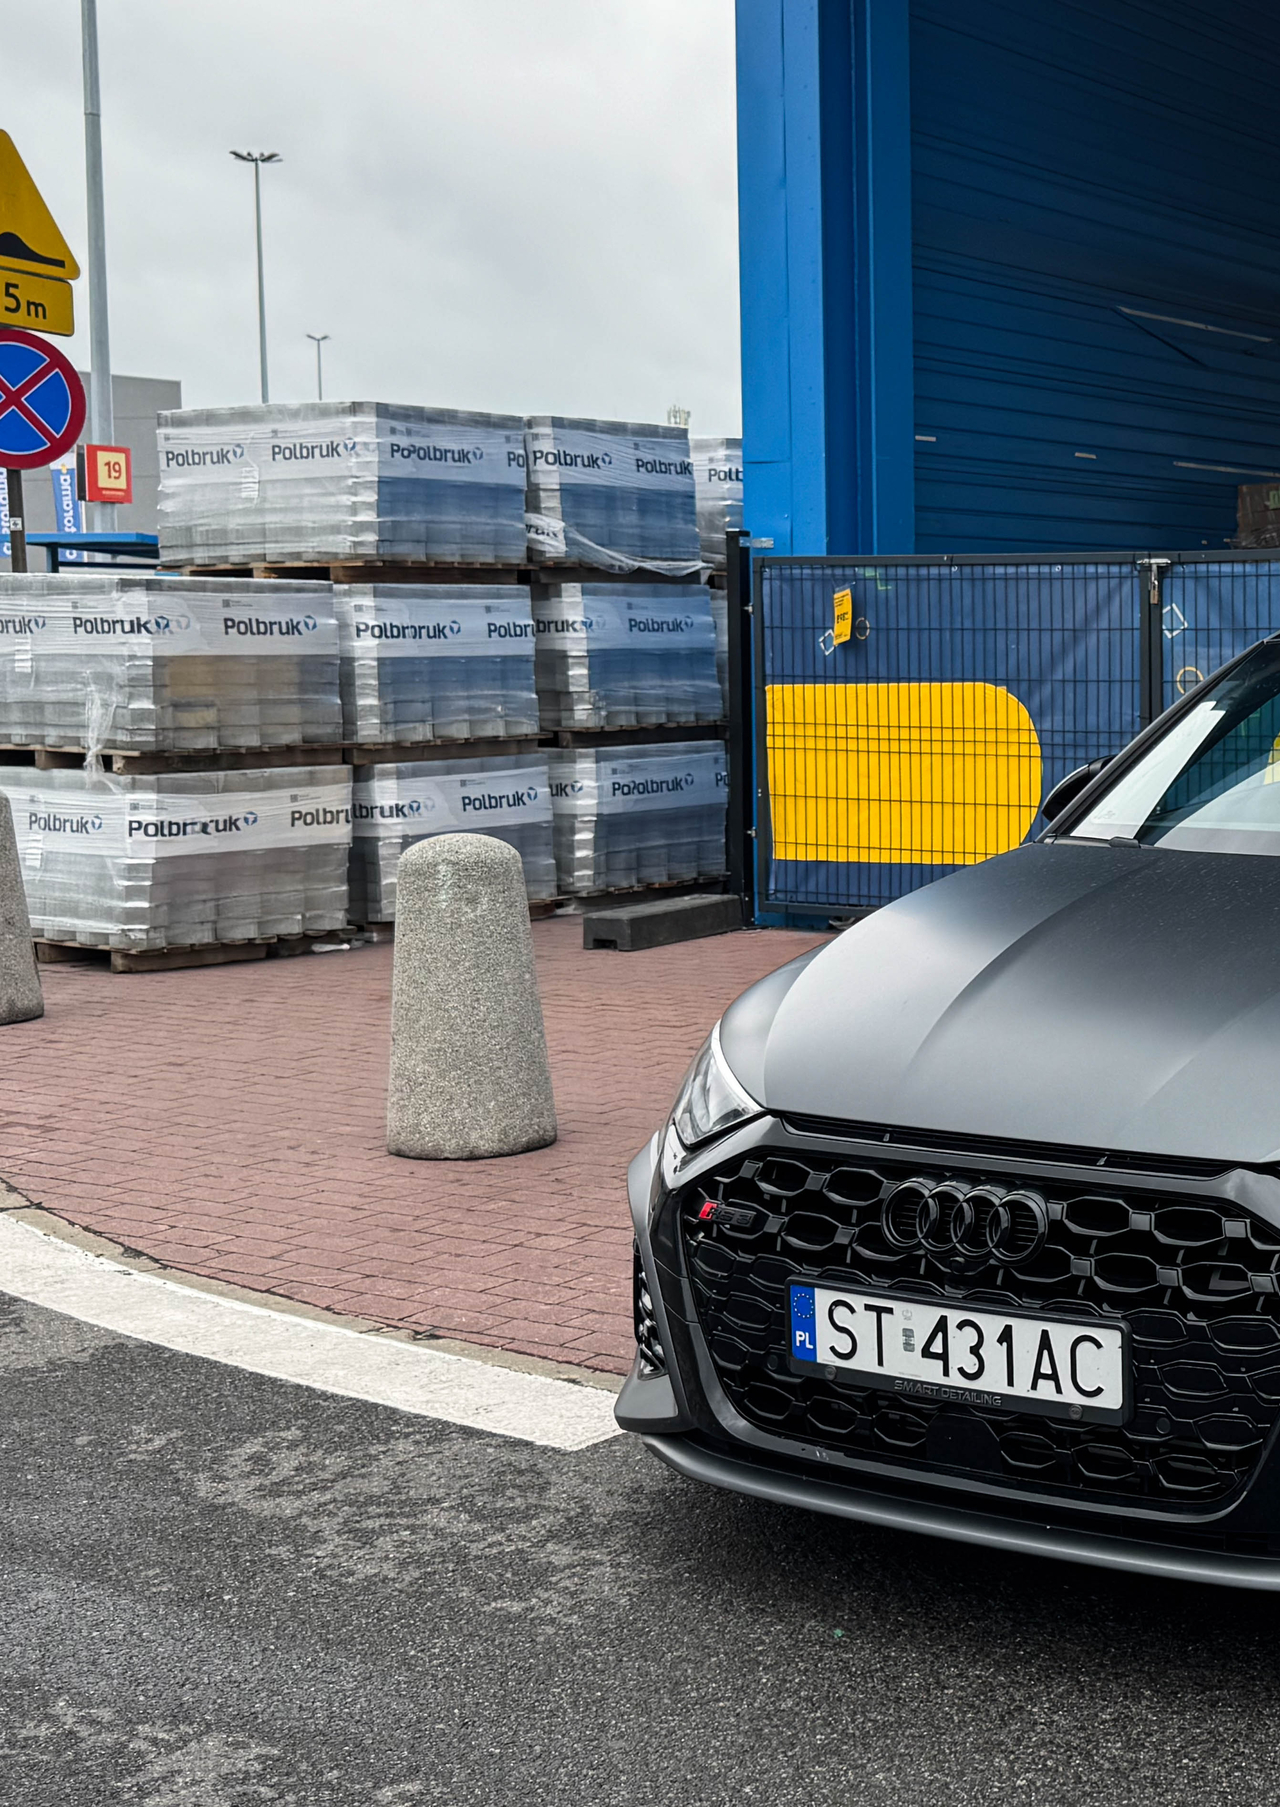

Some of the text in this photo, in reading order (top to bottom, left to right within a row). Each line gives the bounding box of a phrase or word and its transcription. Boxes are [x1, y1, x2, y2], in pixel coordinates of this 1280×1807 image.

[4, 282, 47, 320] 5 m
[165, 441, 341, 468] Polbruk Polbruk
[533, 450, 693, 476] Polbruk Polbruk
[104, 461, 122, 480] 19
[72, 617, 153, 635] Polbruk
[223, 618, 303, 636] Polbruk
[628, 617, 684, 633] Polbruk
[461, 790, 527, 812] Polbruk
[29, 812, 90, 834] Polbruk
[795, 1330, 814, 1349] PL
[827, 1299, 1104, 1398] ST 431AC
[894, 1380, 1002, 1406] SMART DETAILING
